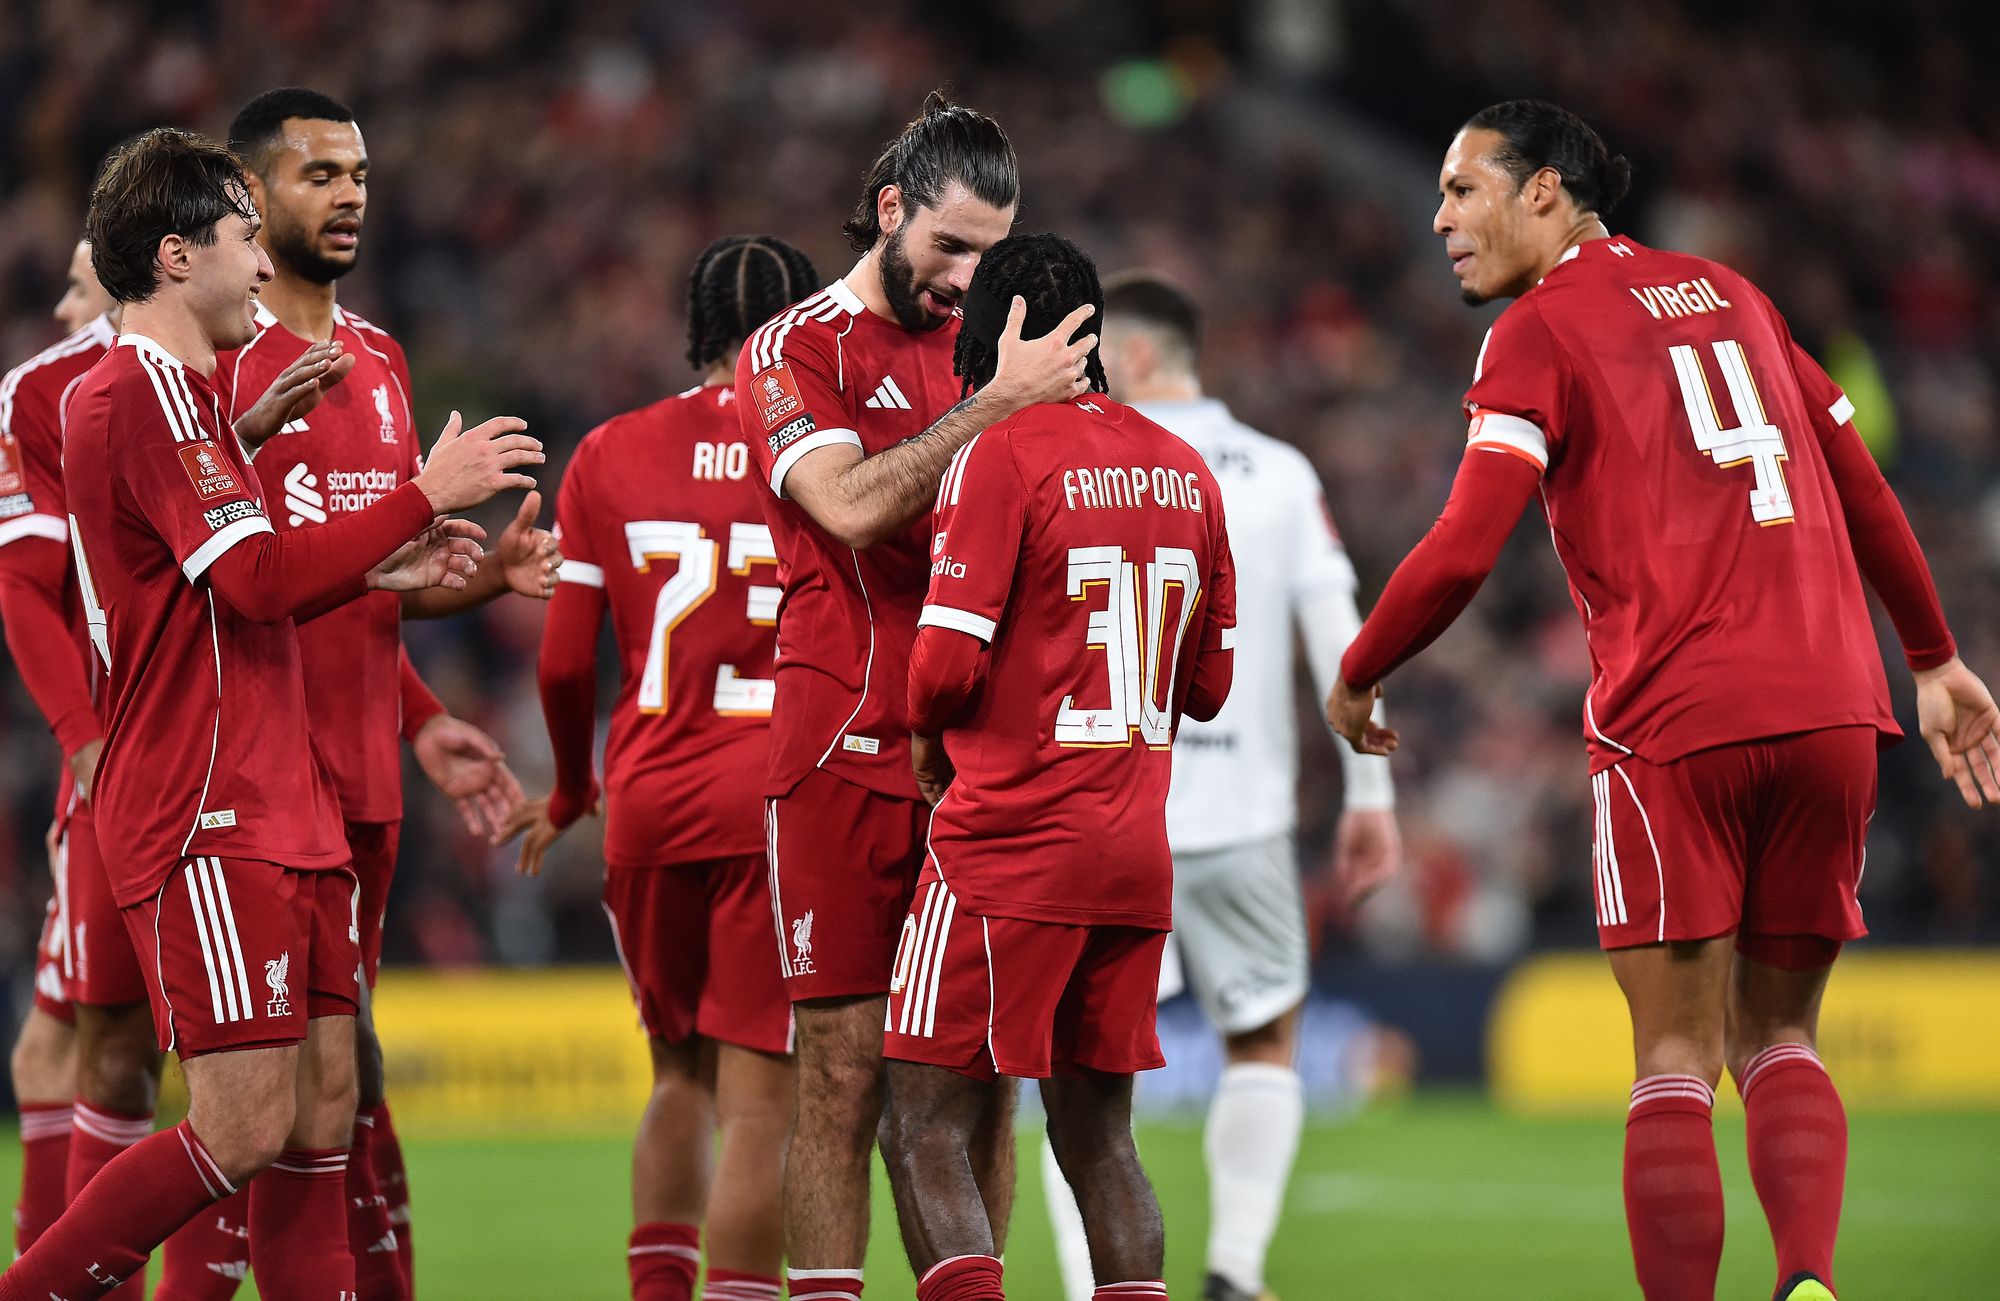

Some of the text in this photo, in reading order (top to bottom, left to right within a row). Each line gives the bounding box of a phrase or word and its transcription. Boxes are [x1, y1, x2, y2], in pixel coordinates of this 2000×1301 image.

[1629, 276, 1732, 320] VIRGIL
[764, 395, 795, 415] Emirates
[766, 400, 798, 424] FA CUP
[777, 417, 808, 440] room
[779, 422, 816, 447] racism
[1668, 339, 1796, 528] 4
[692, 441, 749, 480] RIO
[198, 474, 231, 488] Emirates
[201, 480, 234, 495] FA CUP
[326, 467, 397, 491] standard
[1063, 466, 1203, 512] FRIMPONG
[203, 500, 254, 523] No room
[208, 517, 227, 531] for
[930, 555, 967, 579] edia
[1055, 545, 1203, 751] 30
